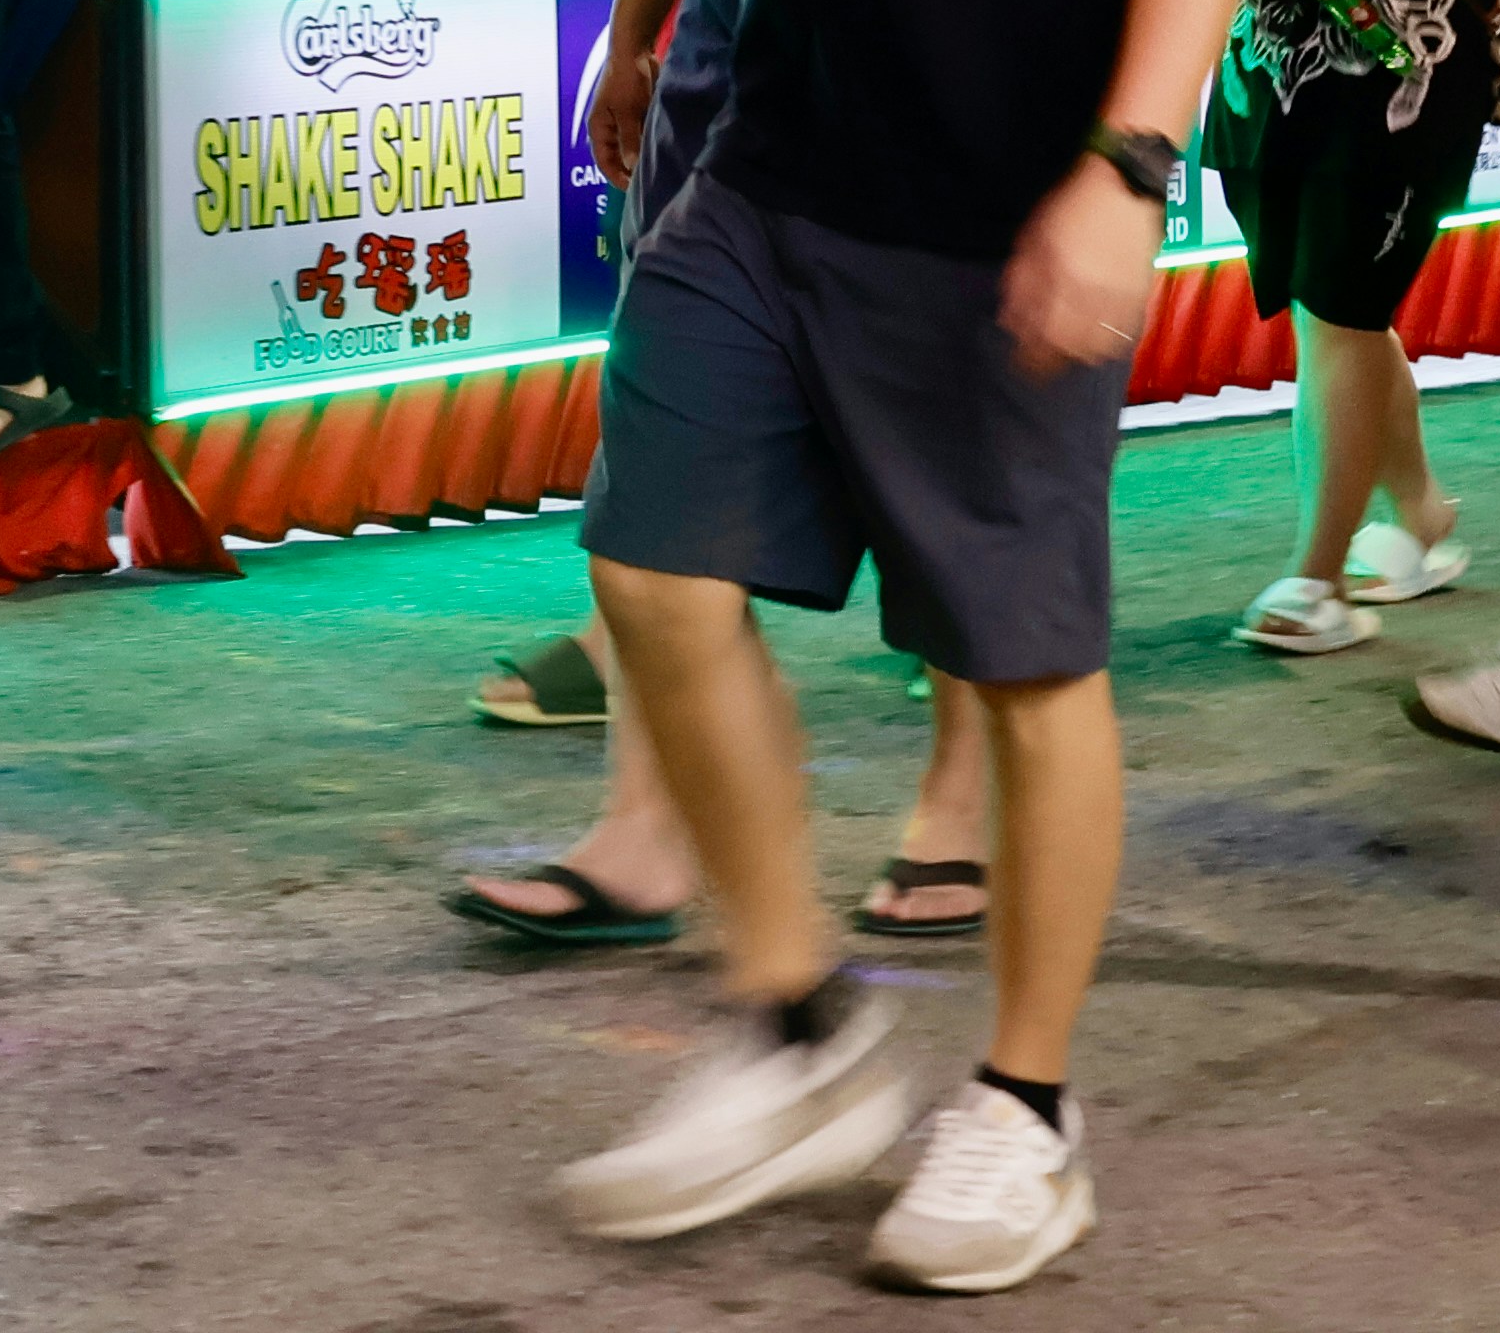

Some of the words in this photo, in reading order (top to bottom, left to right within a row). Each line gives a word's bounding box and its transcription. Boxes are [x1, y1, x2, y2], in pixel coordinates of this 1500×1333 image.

[195, 107, 360, 235] SHAKE
[371, 93, 525, 217] SHAKE
[255, 331, 322, 371] FOOD
[324, 321, 402, 360] COURT
